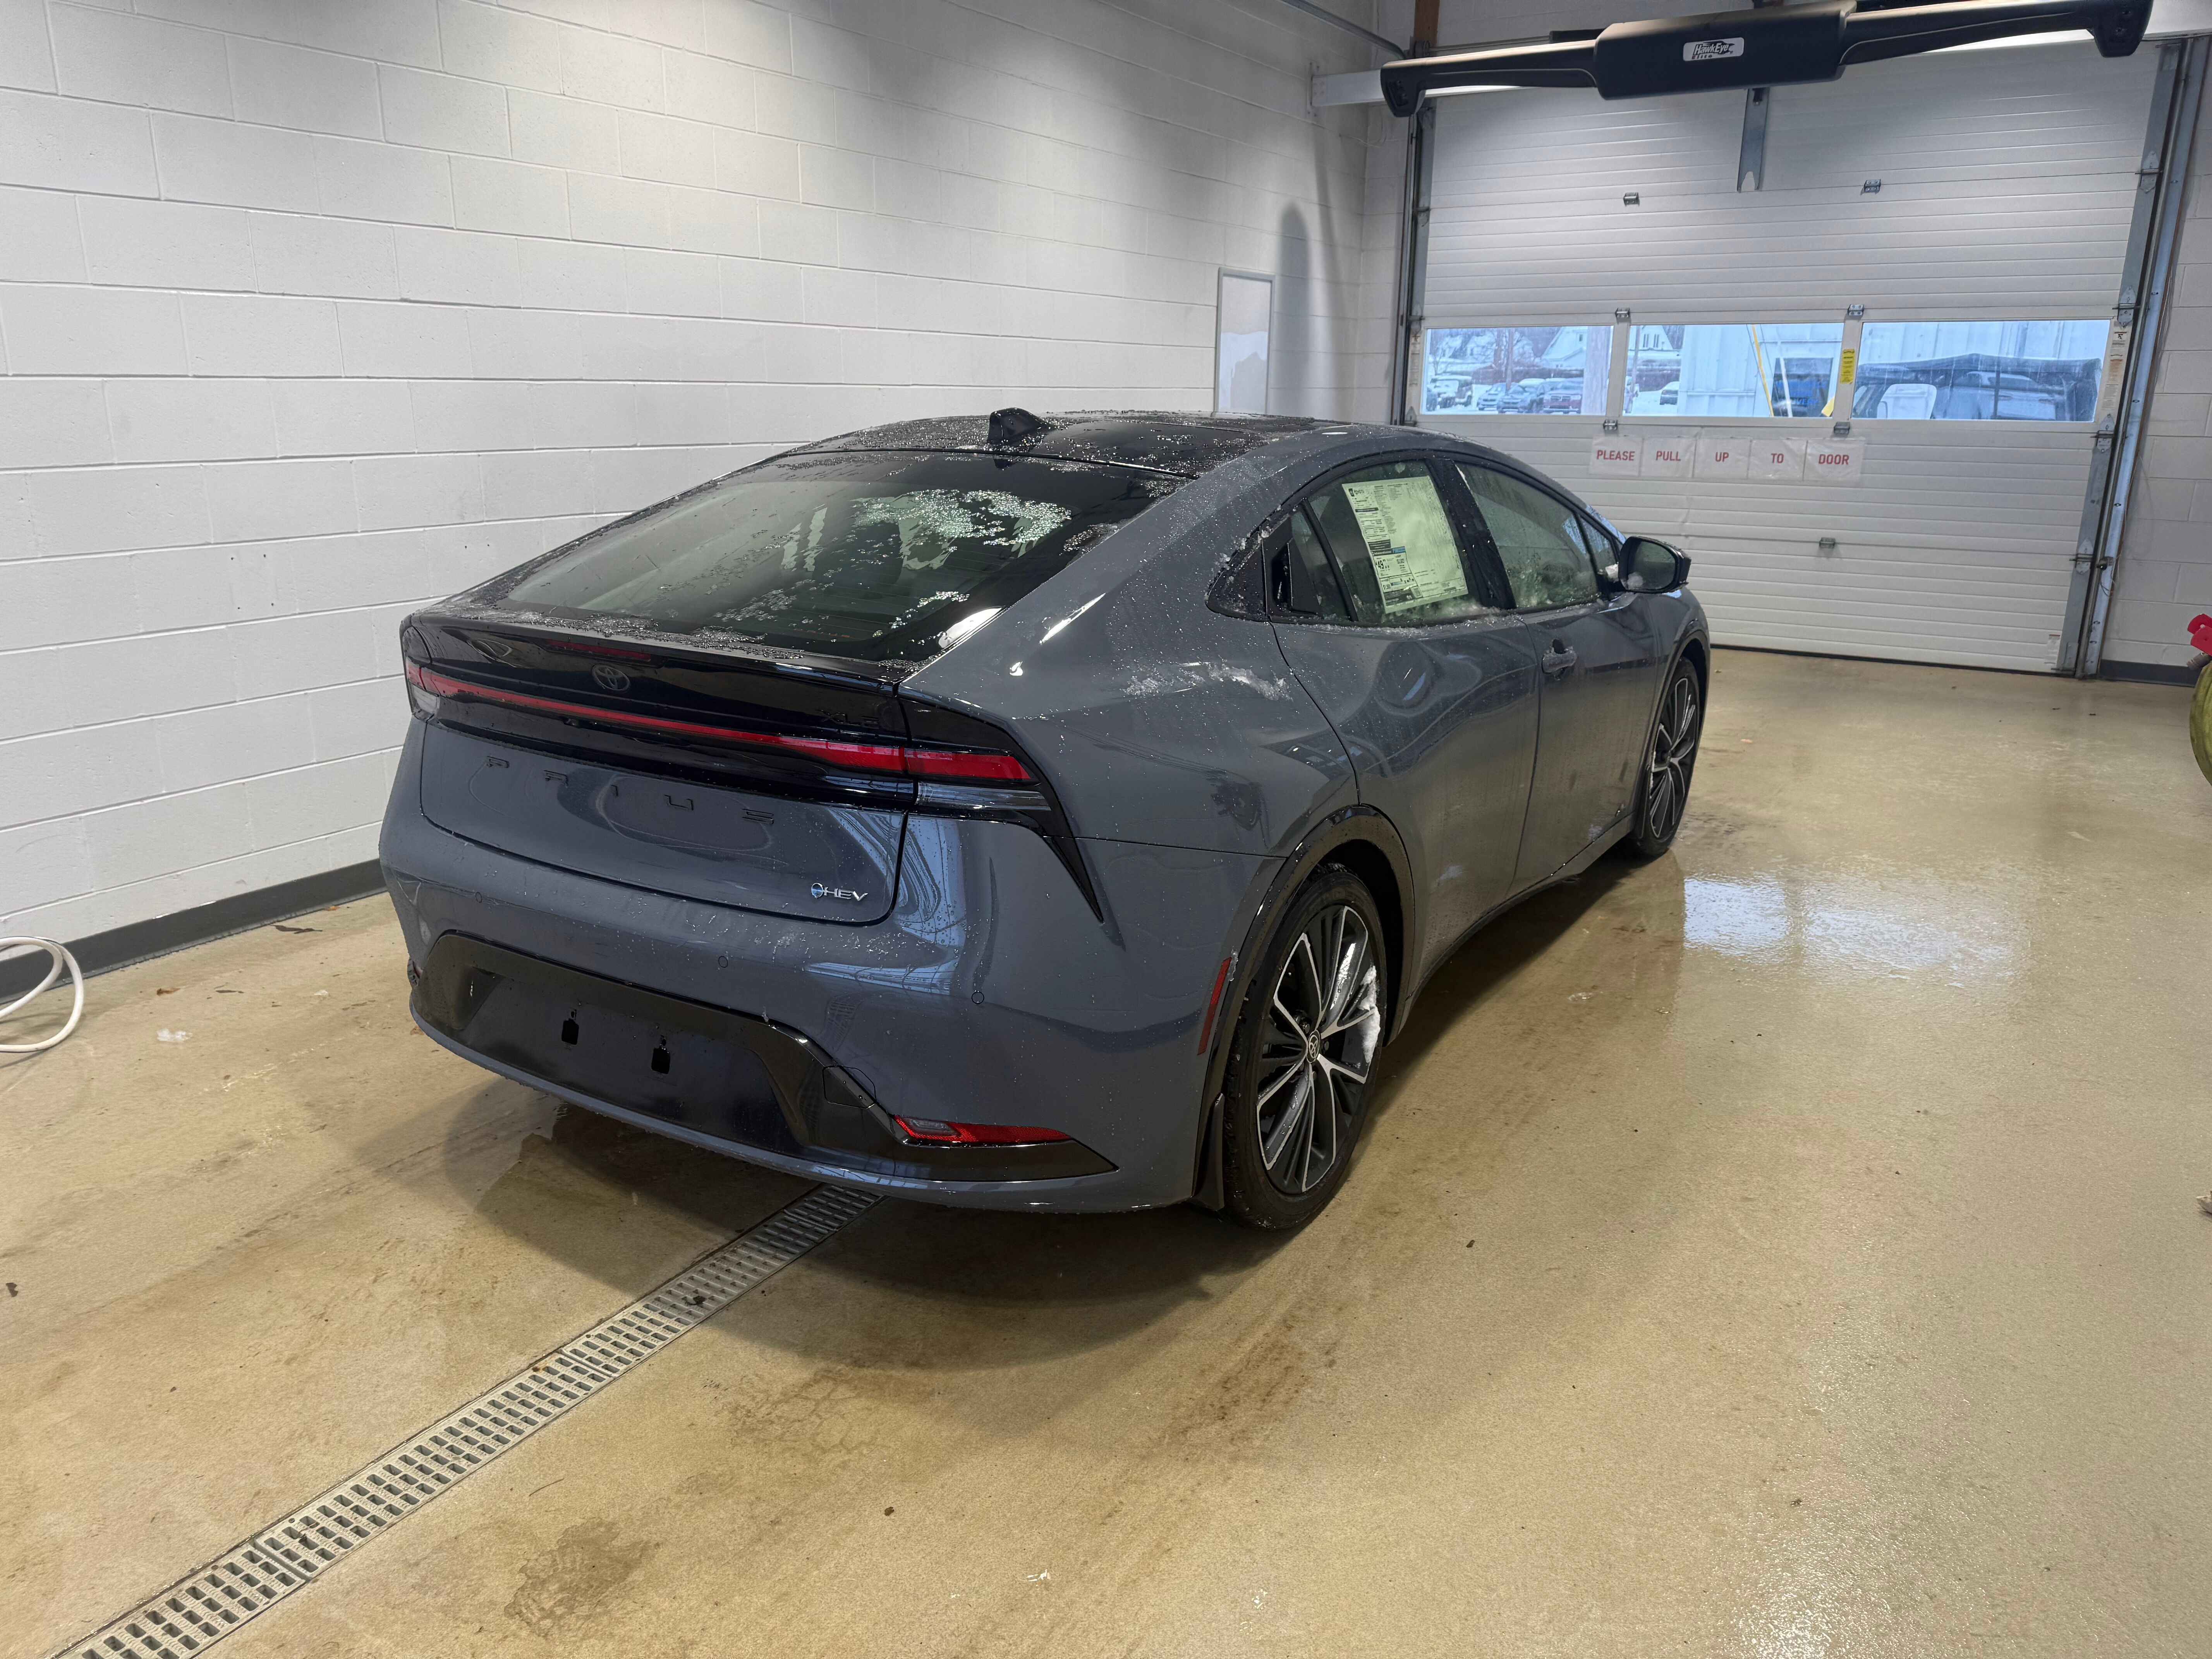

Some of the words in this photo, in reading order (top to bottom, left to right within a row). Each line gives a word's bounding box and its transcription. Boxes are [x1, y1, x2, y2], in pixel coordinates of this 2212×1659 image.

[1693, 42, 1729, 55] HawkEye
[1596, 449, 1635, 461] PLEASE
[1656, 451, 1681, 462] PULL
[1715, 452, 1729, 462] UP
[1771, 453, 1784, 464] TO
[1818, 453, 1850, 465] DOOR
[1377, 560, 1384, 570] 49
[814, 709, 880, 729] XLE
[486, 755, 775, 825] PRIUS
[824, 886, 869, 901] HEV
